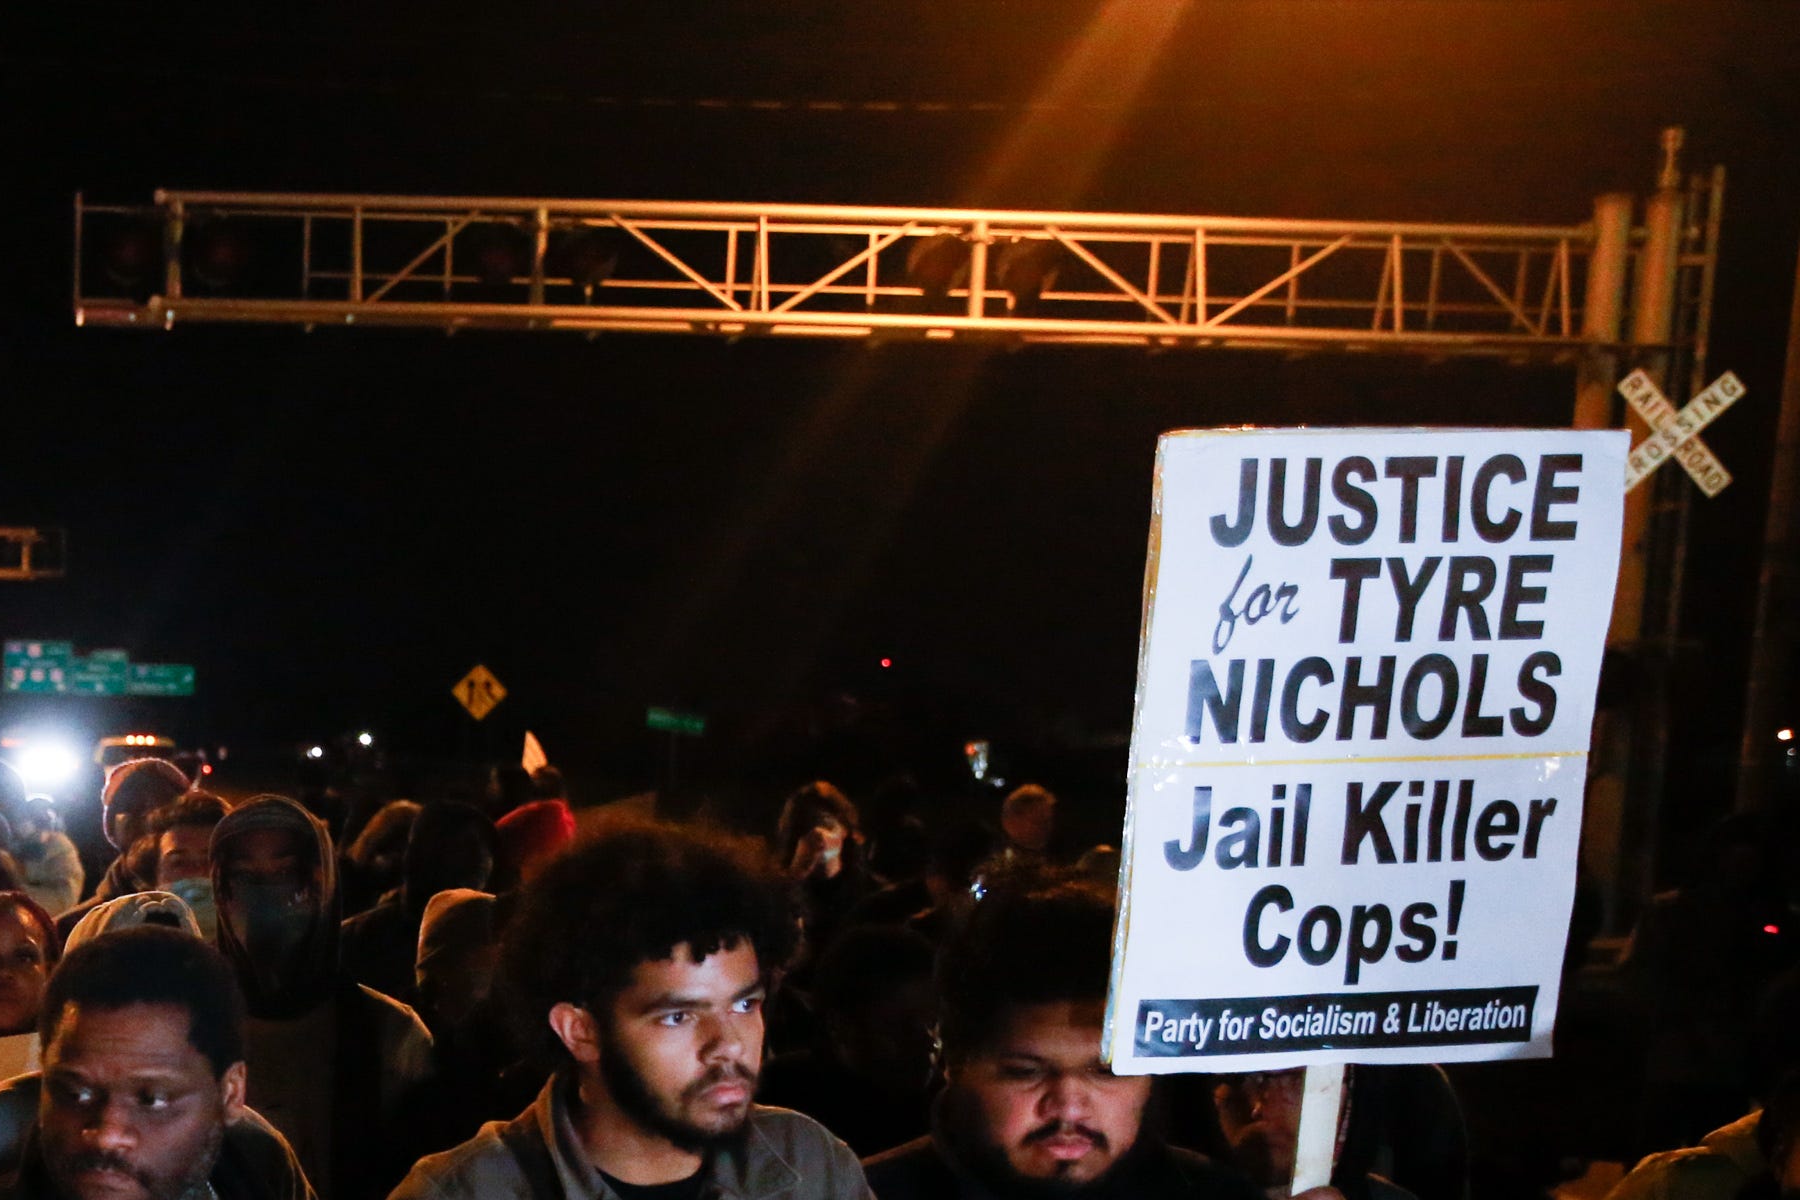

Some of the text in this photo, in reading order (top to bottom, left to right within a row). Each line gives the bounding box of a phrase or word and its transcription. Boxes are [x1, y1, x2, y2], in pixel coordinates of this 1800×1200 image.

[1624, 376, 1723, 490] RAIL ROAD
[1209, 453, 1584, 547] JUSTICE
[1212, 554, 1554, 654] for TYRE
[1185, 651, 1562, 745] NICHOLS
[1163, 779, 1557, 870] Jail Killer
[1243, 879, 1466, 986] Cops!
[1144, 1001, 1526, 1050] Party for Socialism & Liberation
